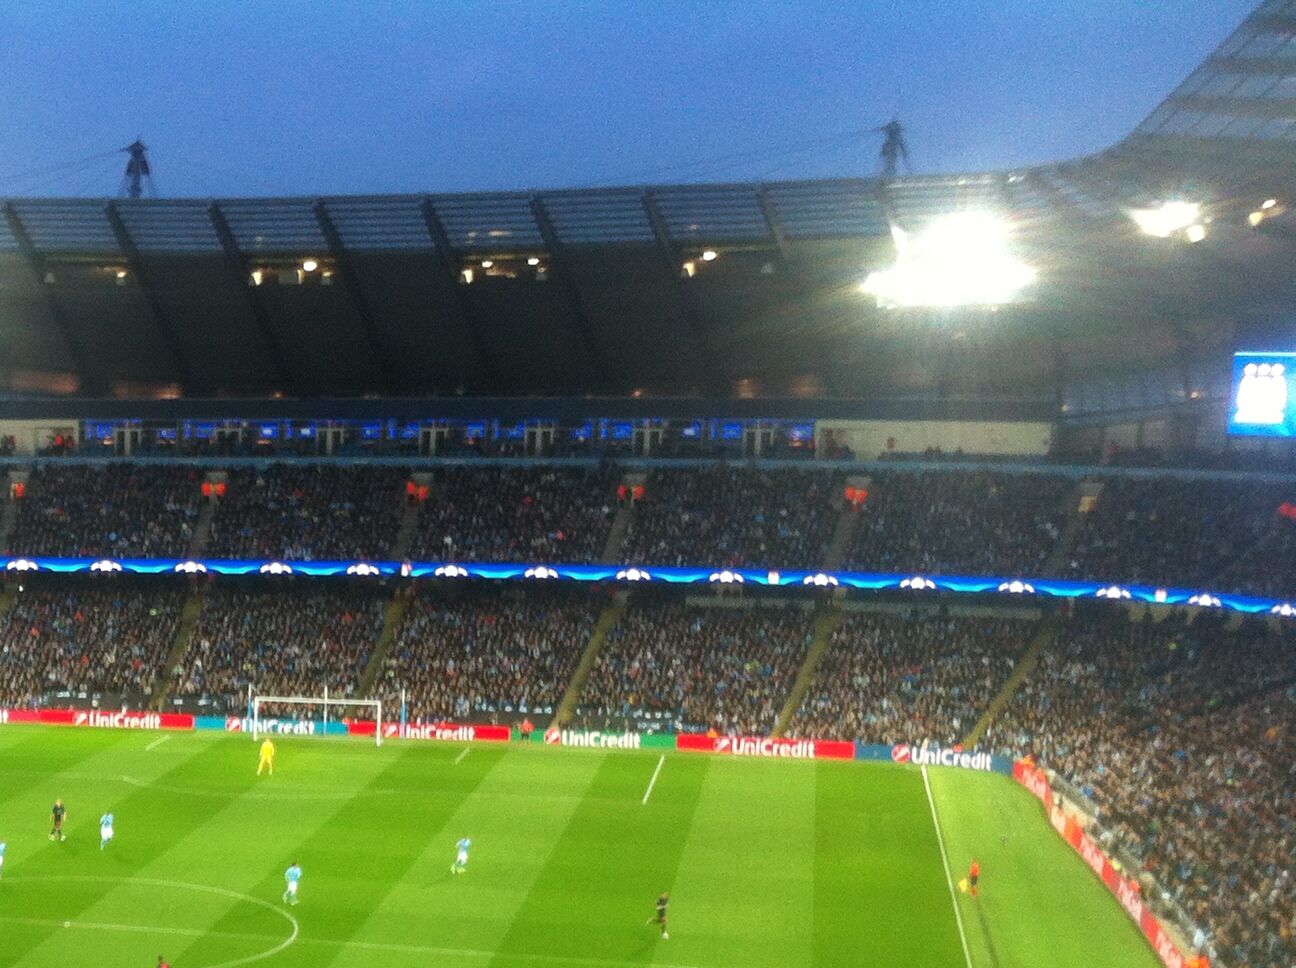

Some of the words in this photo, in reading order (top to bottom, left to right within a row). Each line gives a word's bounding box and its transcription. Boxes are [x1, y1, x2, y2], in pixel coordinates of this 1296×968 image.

[561, 731, 641, 748] UniCredit
[732, 738, 815, 758] UniCredit
[911, 745, 992, 771] UniCredit
